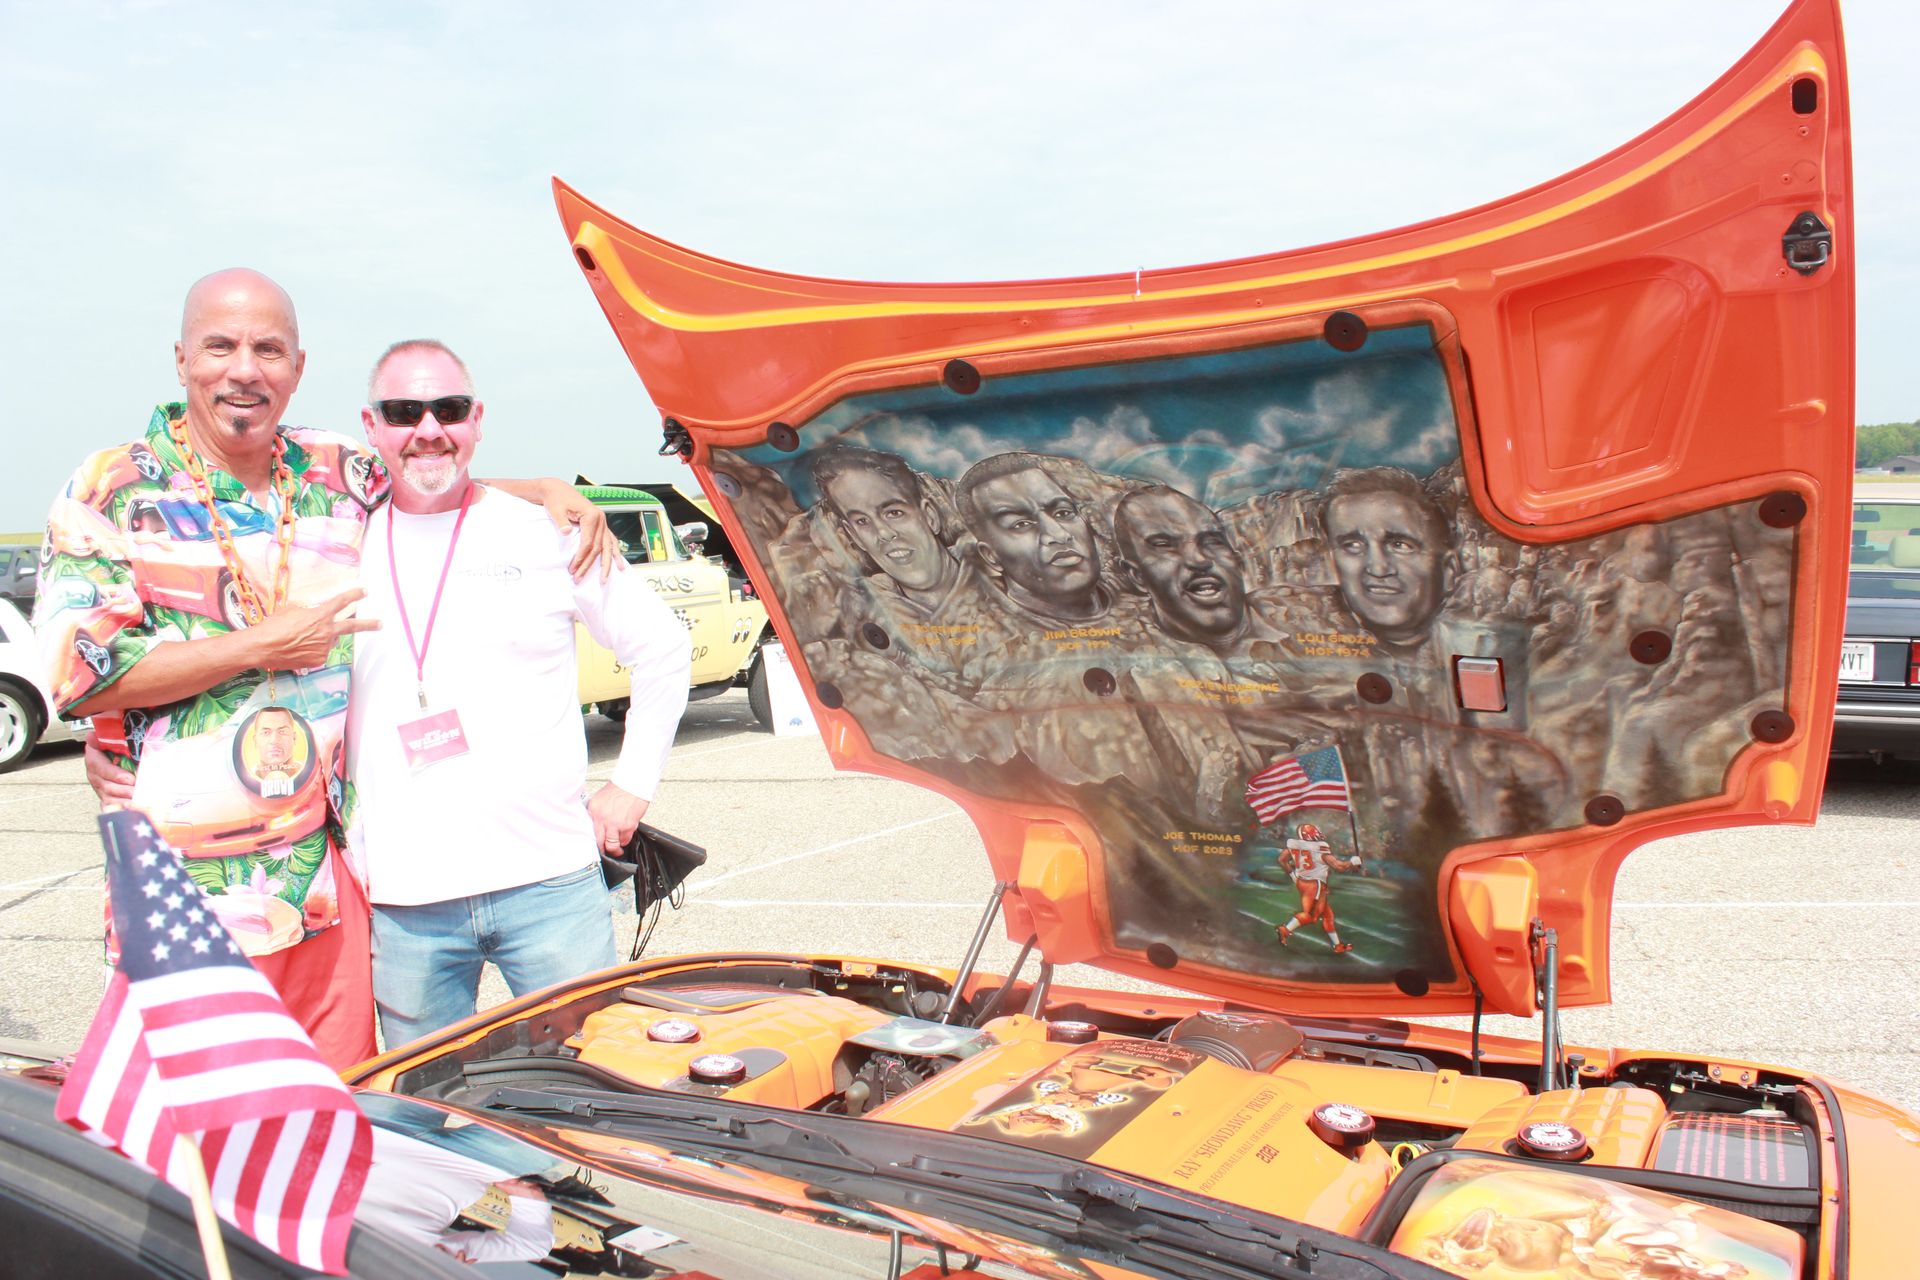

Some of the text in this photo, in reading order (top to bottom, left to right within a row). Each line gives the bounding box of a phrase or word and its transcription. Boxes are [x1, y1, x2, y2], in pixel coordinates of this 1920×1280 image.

[1041, 627, 1121, 641] JIM BROWN
[1296, 632, 1378, 645] LOU GROZA
[1056, 640, 1082, 651] HOF
[1304, 646, 1371, 658] HOF 1974
[1162, 831, 1243, 844] JOE THOMAS
[1172, 844, 1234, 857] HOF 2023
[1291, 848, 1316, 871] 73
[1254, 1143, 1281, 1165] 2021
[1173, 1157, 1202, 1180] RAY
